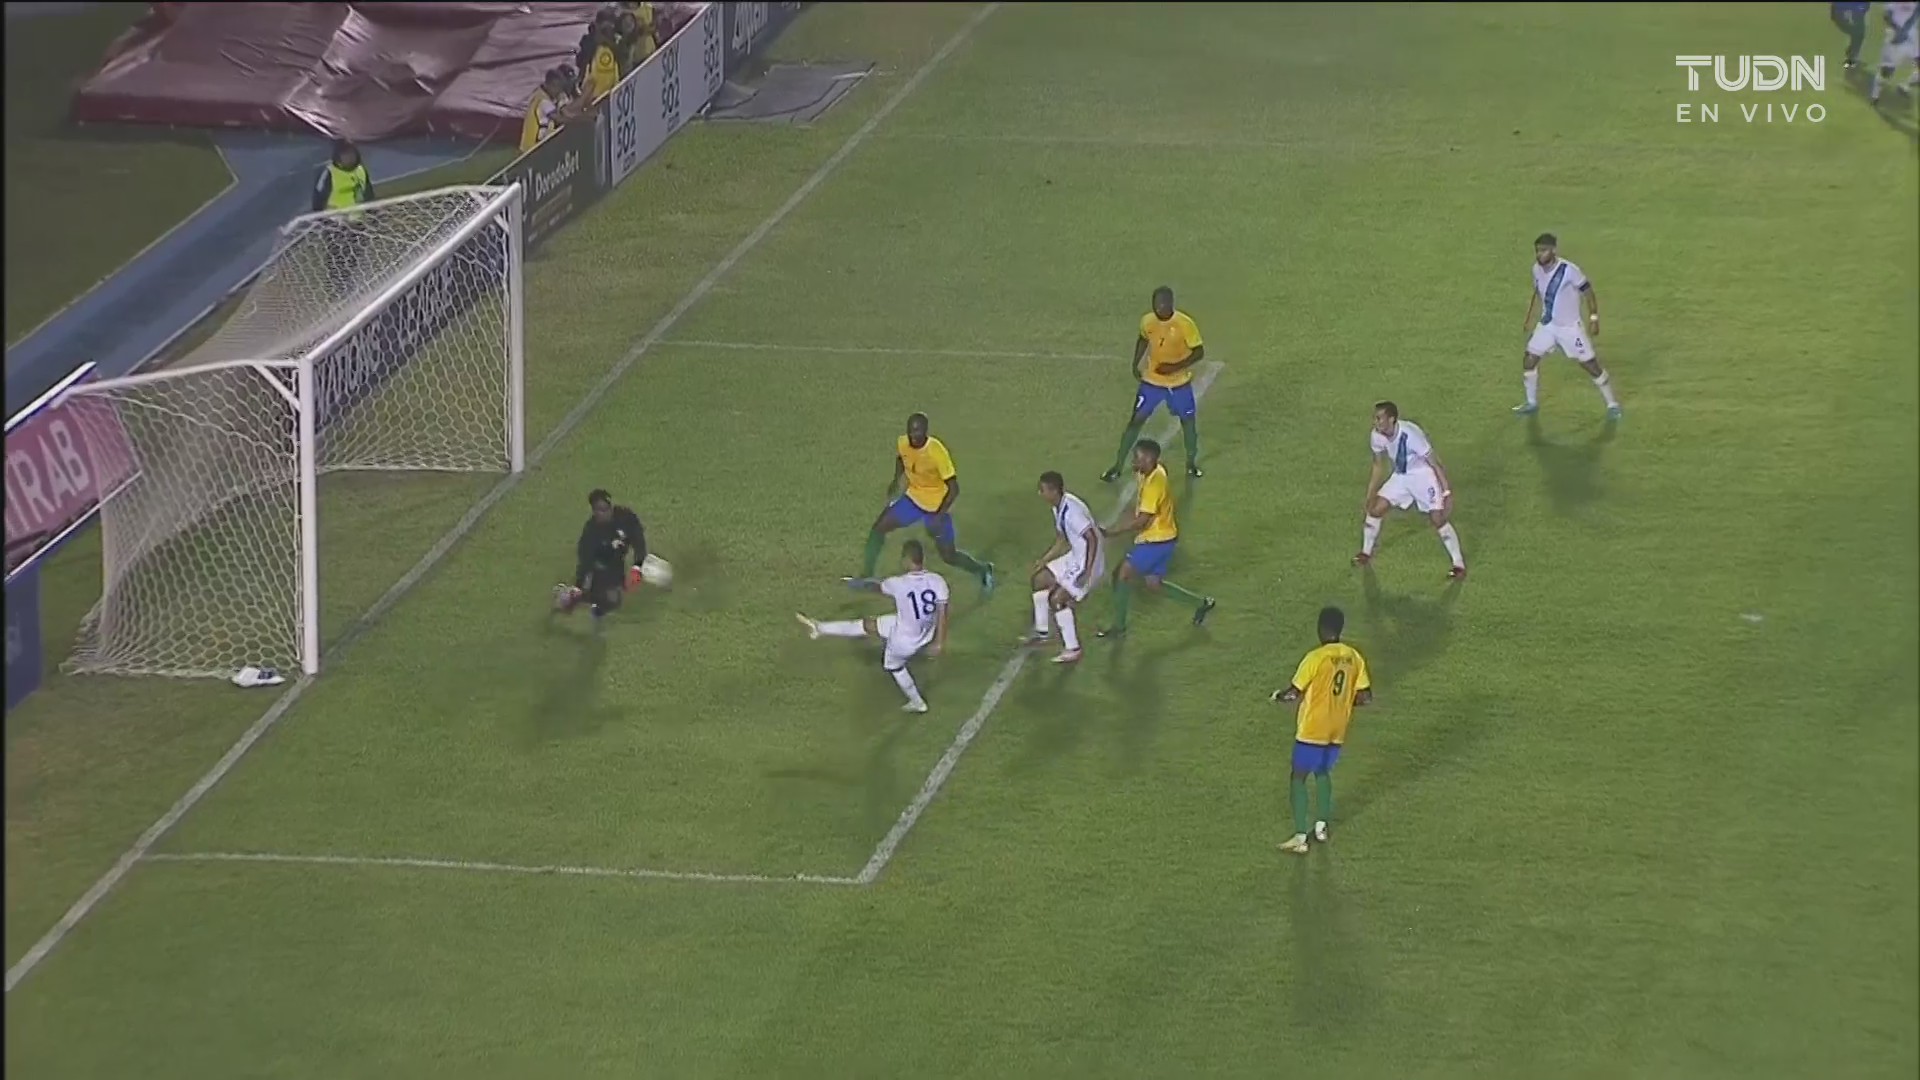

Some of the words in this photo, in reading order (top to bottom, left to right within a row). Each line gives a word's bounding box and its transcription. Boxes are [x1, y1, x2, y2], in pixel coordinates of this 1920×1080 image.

[661, 38, 681, 84] SOY
[616, 79, 637, 123] SOY
[661, 77, 681, 119] 502
[616, 116, 637, 159] 502
[906, 588, 938, 620] 18
[1332, 669, 1346, 697] 9
